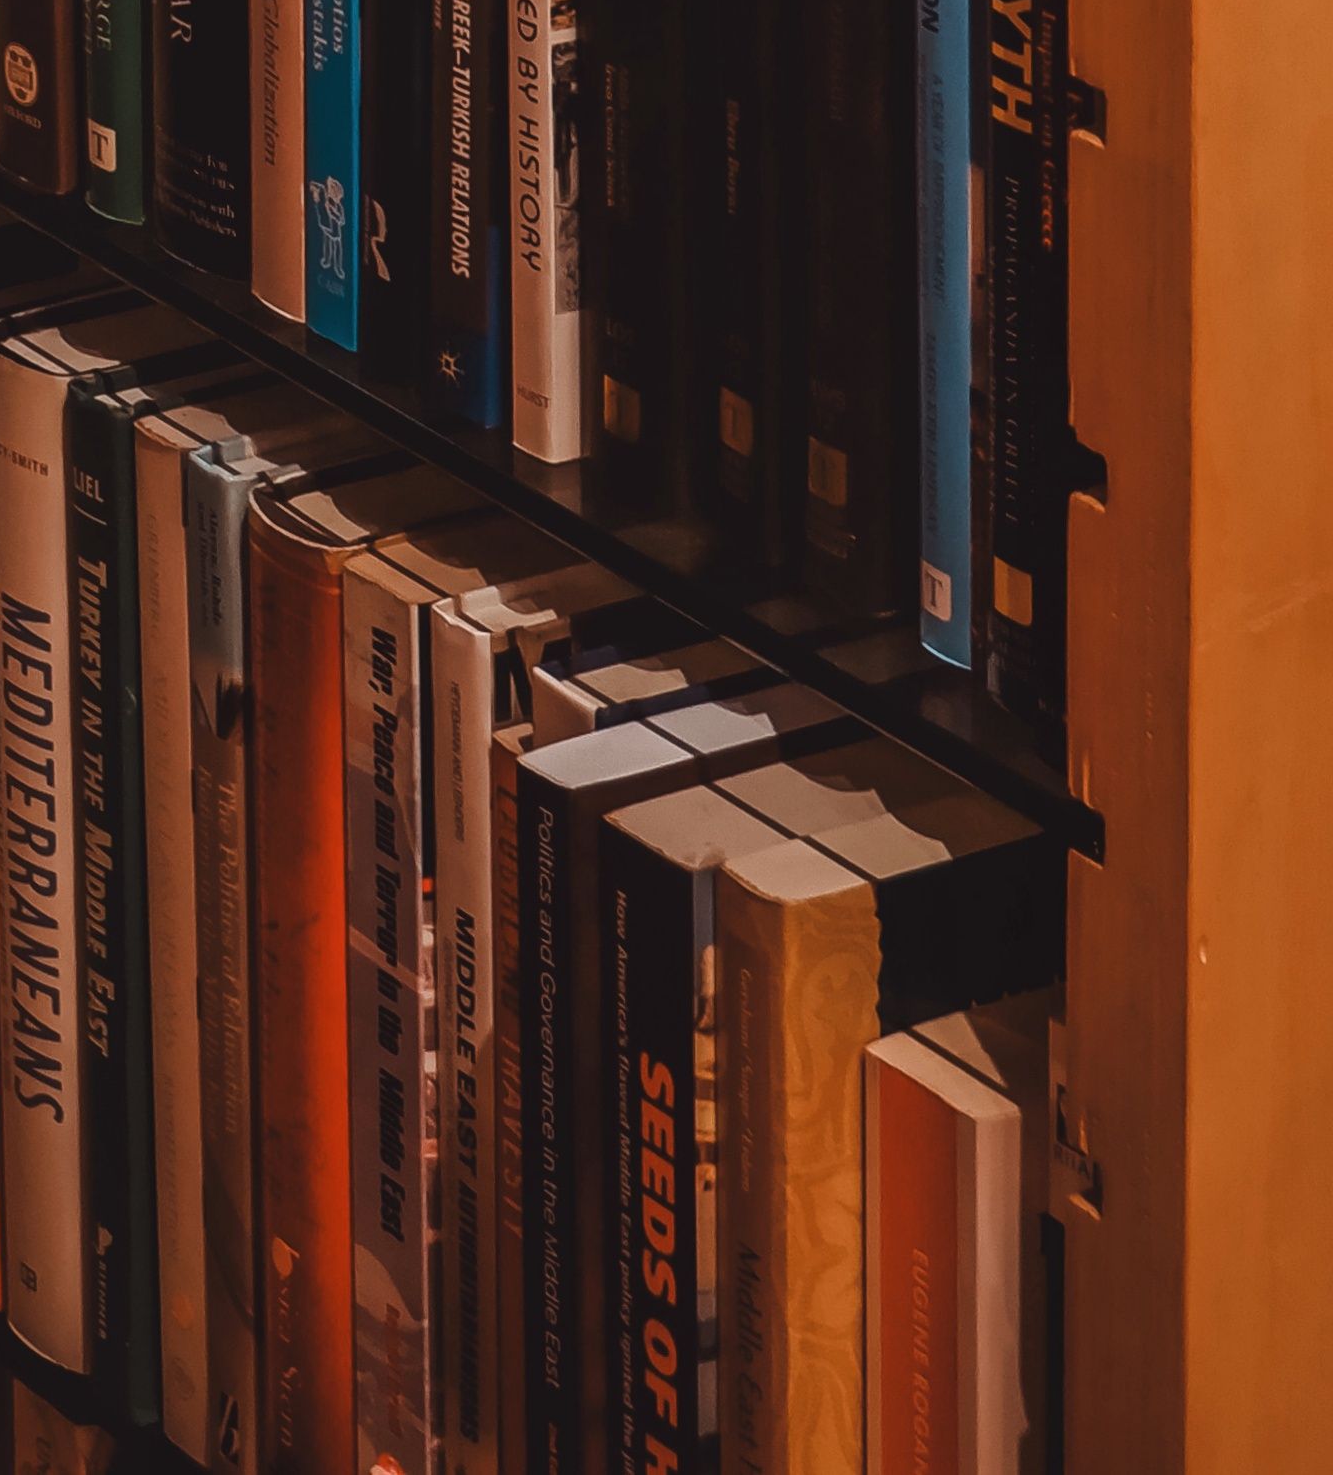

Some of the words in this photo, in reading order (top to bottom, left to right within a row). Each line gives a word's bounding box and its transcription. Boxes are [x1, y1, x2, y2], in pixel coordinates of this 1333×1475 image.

[518, 57, 540, 103] BY
[451, 162, 471, 277] RELATIONS
[518, 115, 542, 272] HISTORY
[0, 592, 64, 1124] MEDITERRANEANS
[538, 807, 555, 904] Politics
[540, 910, 555, 965] and
[539, 975, 555, 1140] Governance
[543, 1147, 558, 1172] in
[543, 1178, 558, 1225] the
[640, 1053, 674, 1307] SEEDS
[543, 1231, 561, 1324] Middle
[545, 1331, 561, 1389] East
[643, 1318, 677, 1428] OF
